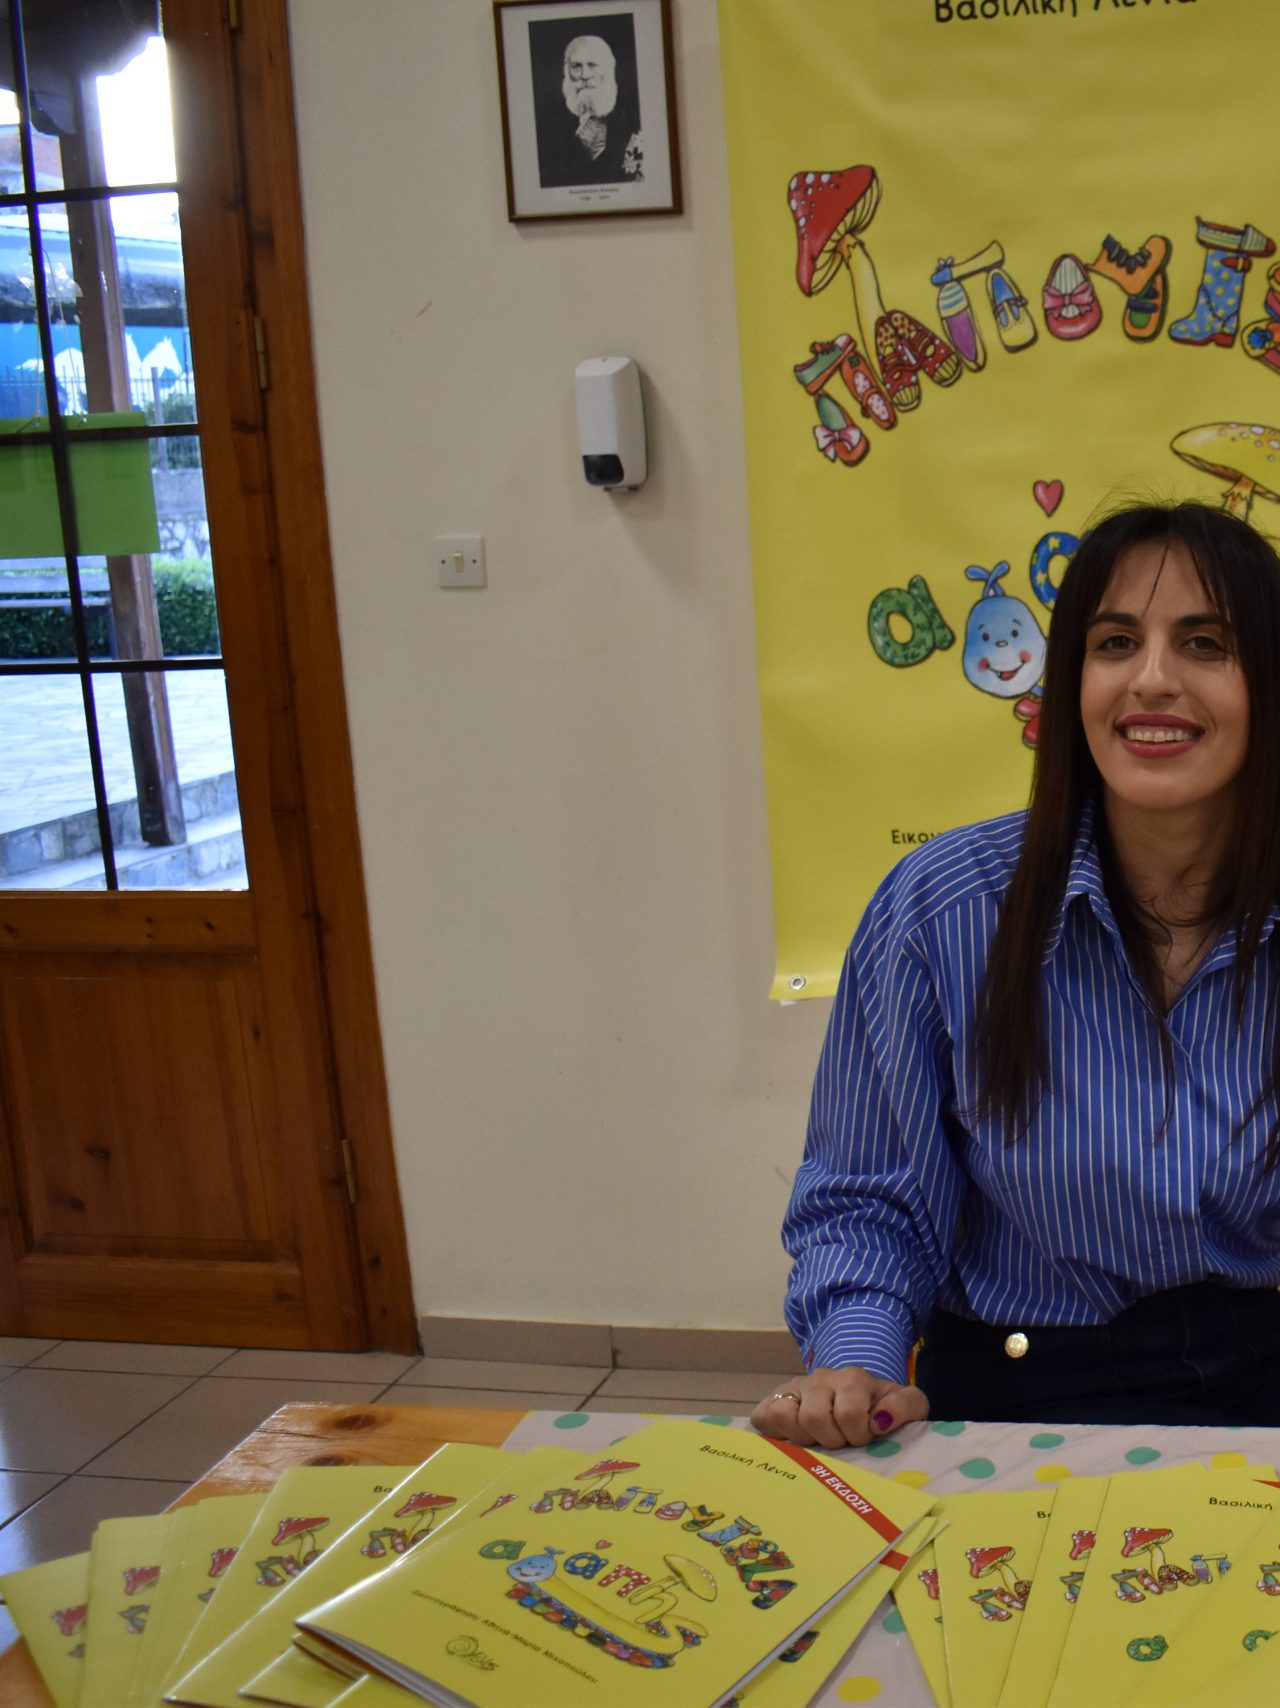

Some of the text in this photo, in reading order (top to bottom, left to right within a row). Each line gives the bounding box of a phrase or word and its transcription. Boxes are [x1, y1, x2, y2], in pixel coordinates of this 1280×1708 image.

[699, 1444, 797, 1481] Βασιλική Λέντα
[810, 1465, 873, 1515] 3Η ΕΚΔΟΣΗ
[1209, 1496, 1273, 1511] Βασιλική
